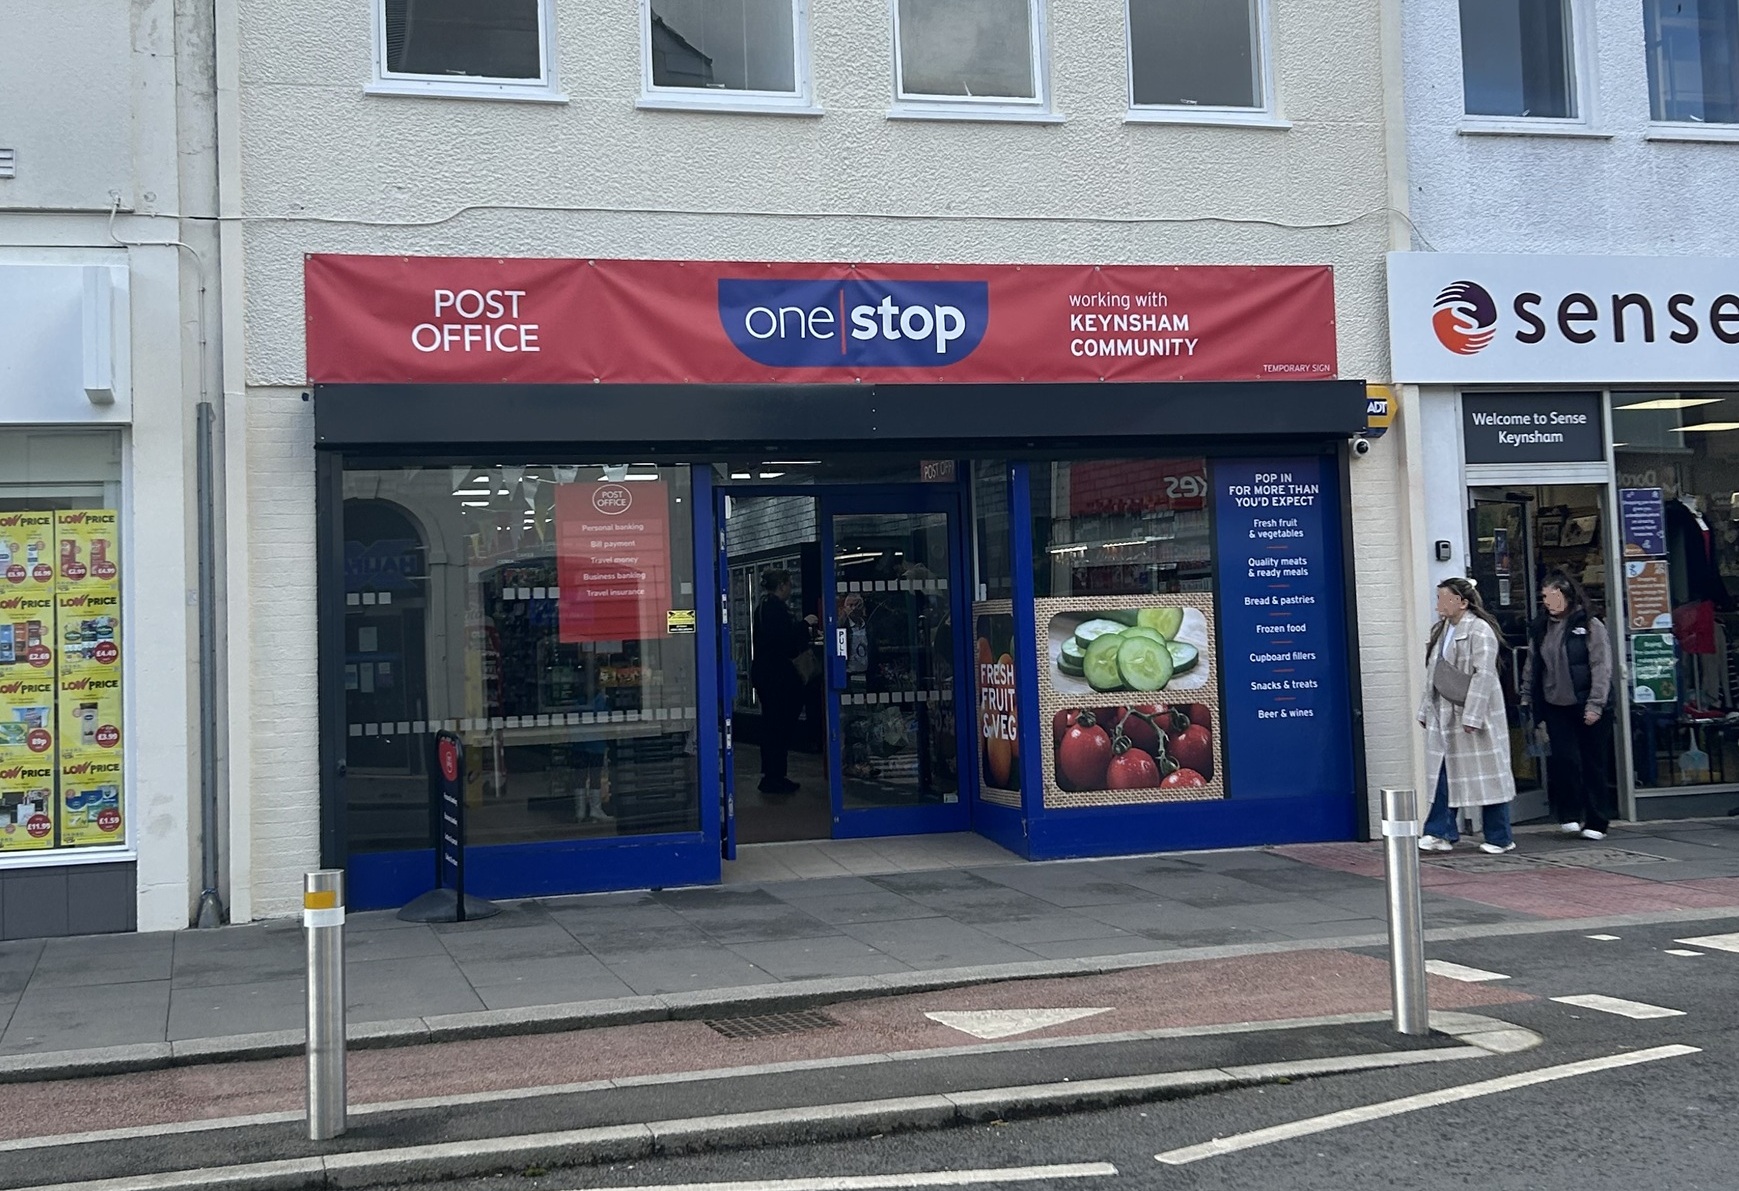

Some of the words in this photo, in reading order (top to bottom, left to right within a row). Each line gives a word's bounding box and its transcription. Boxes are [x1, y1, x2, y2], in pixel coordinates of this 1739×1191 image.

[434, 289, 525, 319] POST
[1069, 291, 1130, 310] working
[1135, 292, 1167, 308] with
[1070, 314, 1189, 332] KEYNSHAM
[1513, 292, 1739, 344] sense
[745, 307, 834, 340] one
[850, 295, 966, 355] stop
[412, 323, 540, 353] OFFICE
[1070, 338, 1199, 357] COMMUNITY
[1263, 364, 1309, 373] TEMPORARY
[1312, 364, 1330, 373] SIGN
[1367, 401, 1387, 413] ADT
[1472, 411, 1531, 426] Welcome
[1533, 413, 1546, 426] to
[1550, 411, 1587, 425] Sense
[1498, 429, 1563, 445] Keynsham
[924, 463, 939, 480] POST
[1255, 474, 1277, 483] POP
[1281, 473, 1292, 482] IN
[1229, 486, 1251, 495] FOR
[1254, 485, 1285, 494] MORE
[1288, 485, 1318, 494] THAN
[597, 499, 627, 507] OFFICE
[1236, 498, 1269, 506] YOU'D
[1272, 496, 1314, 506] EXPECT
[0, 514, 22, 526] OW
[21, 518, 50, 527] PRICE
[85, 515, 115, 524] PRICE
[1254, 519, 1277, 527] Fresh
[615, 523, 644, 531] banking
[1249, 530, 1255, 538] &
[1258, 529, 1304, 539] vegetables
[604, 541, 635, 549] payment
[1248, 558, 1278, 566] Quality
[1281, 557, 1307, 565] meats
[618, 572, 646, 580] banking
[1248, 568, 1255, 577] &
[1257, 568, 1280, 578] ready
[1283, 568, 1308, 576] meals
[0, 596, 23, 609] OW
[21, 600, 51, 609] PRICE
[88, 597, 117, 607] PRICE
[1245, 596, 1270, 605] Bread
[1272, 596, 1278, 604] &
[1281, 595, 1315, 606] pastries
[1256, 625, 1285, 633] Frozen
[1287, 624, 1306, 632] food
[1250, 652, 1290, 662] Cupboard
[1292, 652, 1316, 660] fillers
[981, 664, 1014, 685] FRESH
[0, 681, 23, 694] OW
[21, 684, 51, 694] PRICE
[89, 680, 118, 690] PRICE
[1251, 681, 1281, 690] Snacks
[1284, 680, 1290, 688] &
[1292, 680, 1318, 688] treats
[982, 688, 1015, 711] FRUIT
[1258, 710, 1279, 718] Beer
[1281, 709, 1287, 718] &
[1289, 708, 1314, 716] wines
[983, 714, 991, 738] &
[991, 715, 1017, 741] VEG
[0, 766, 23, 779] OW
[21, 769, 51, 779] PRICE
[90, 764, 120, 774] PRICE
